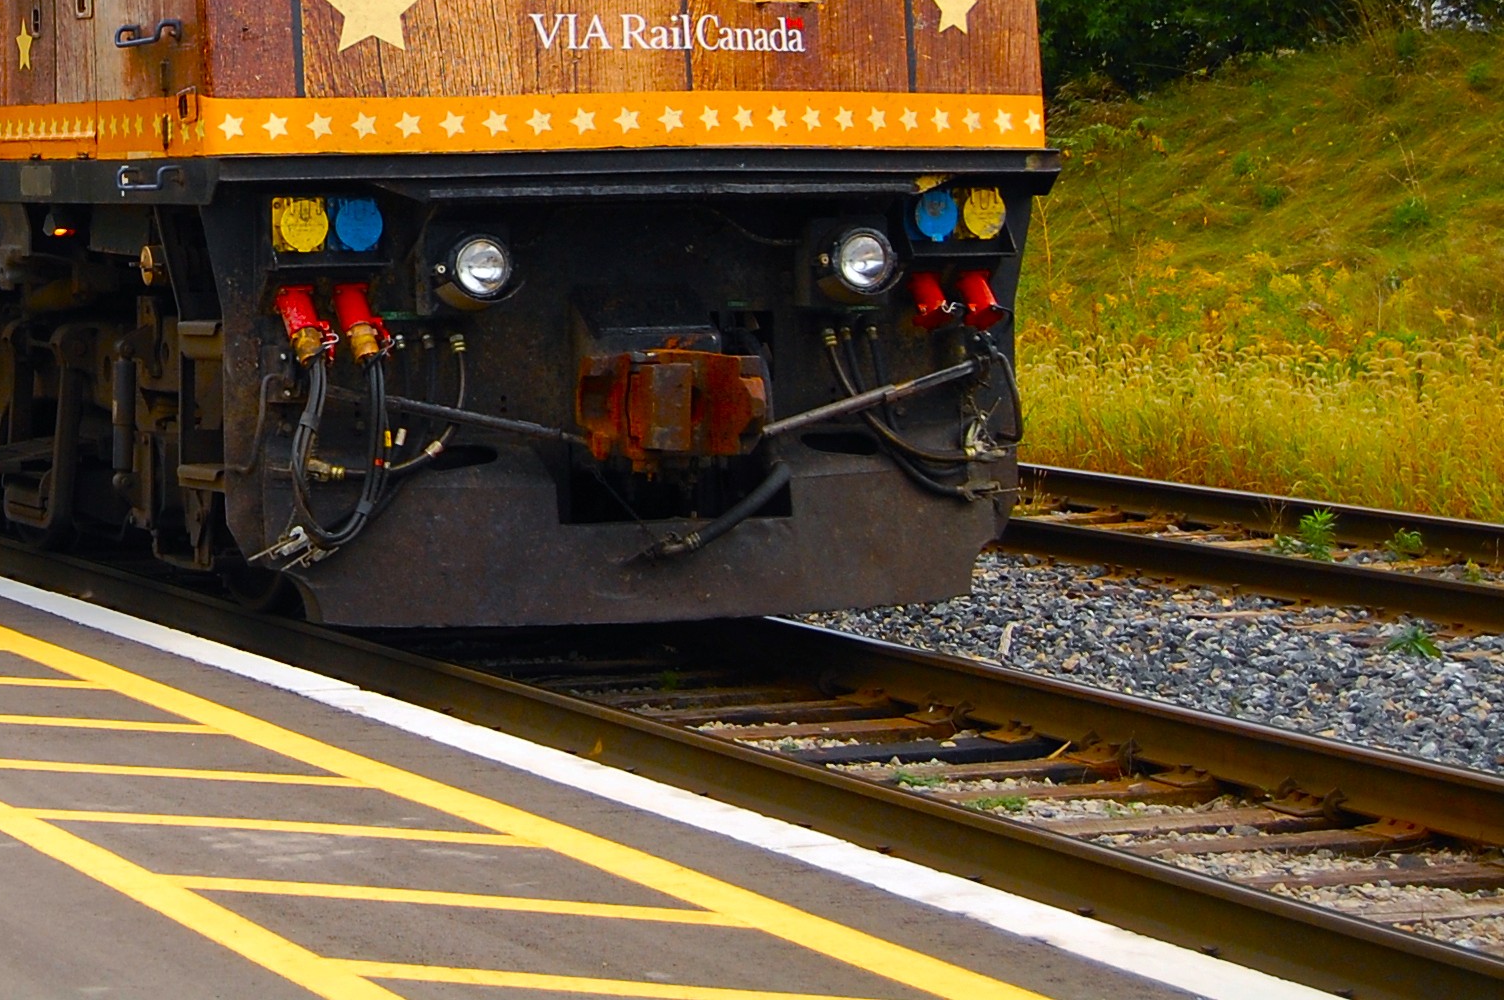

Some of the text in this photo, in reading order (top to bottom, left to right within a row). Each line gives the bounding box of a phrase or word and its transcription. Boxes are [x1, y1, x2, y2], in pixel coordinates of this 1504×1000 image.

[529, 13, 806, 53] VIA Rail Canada
